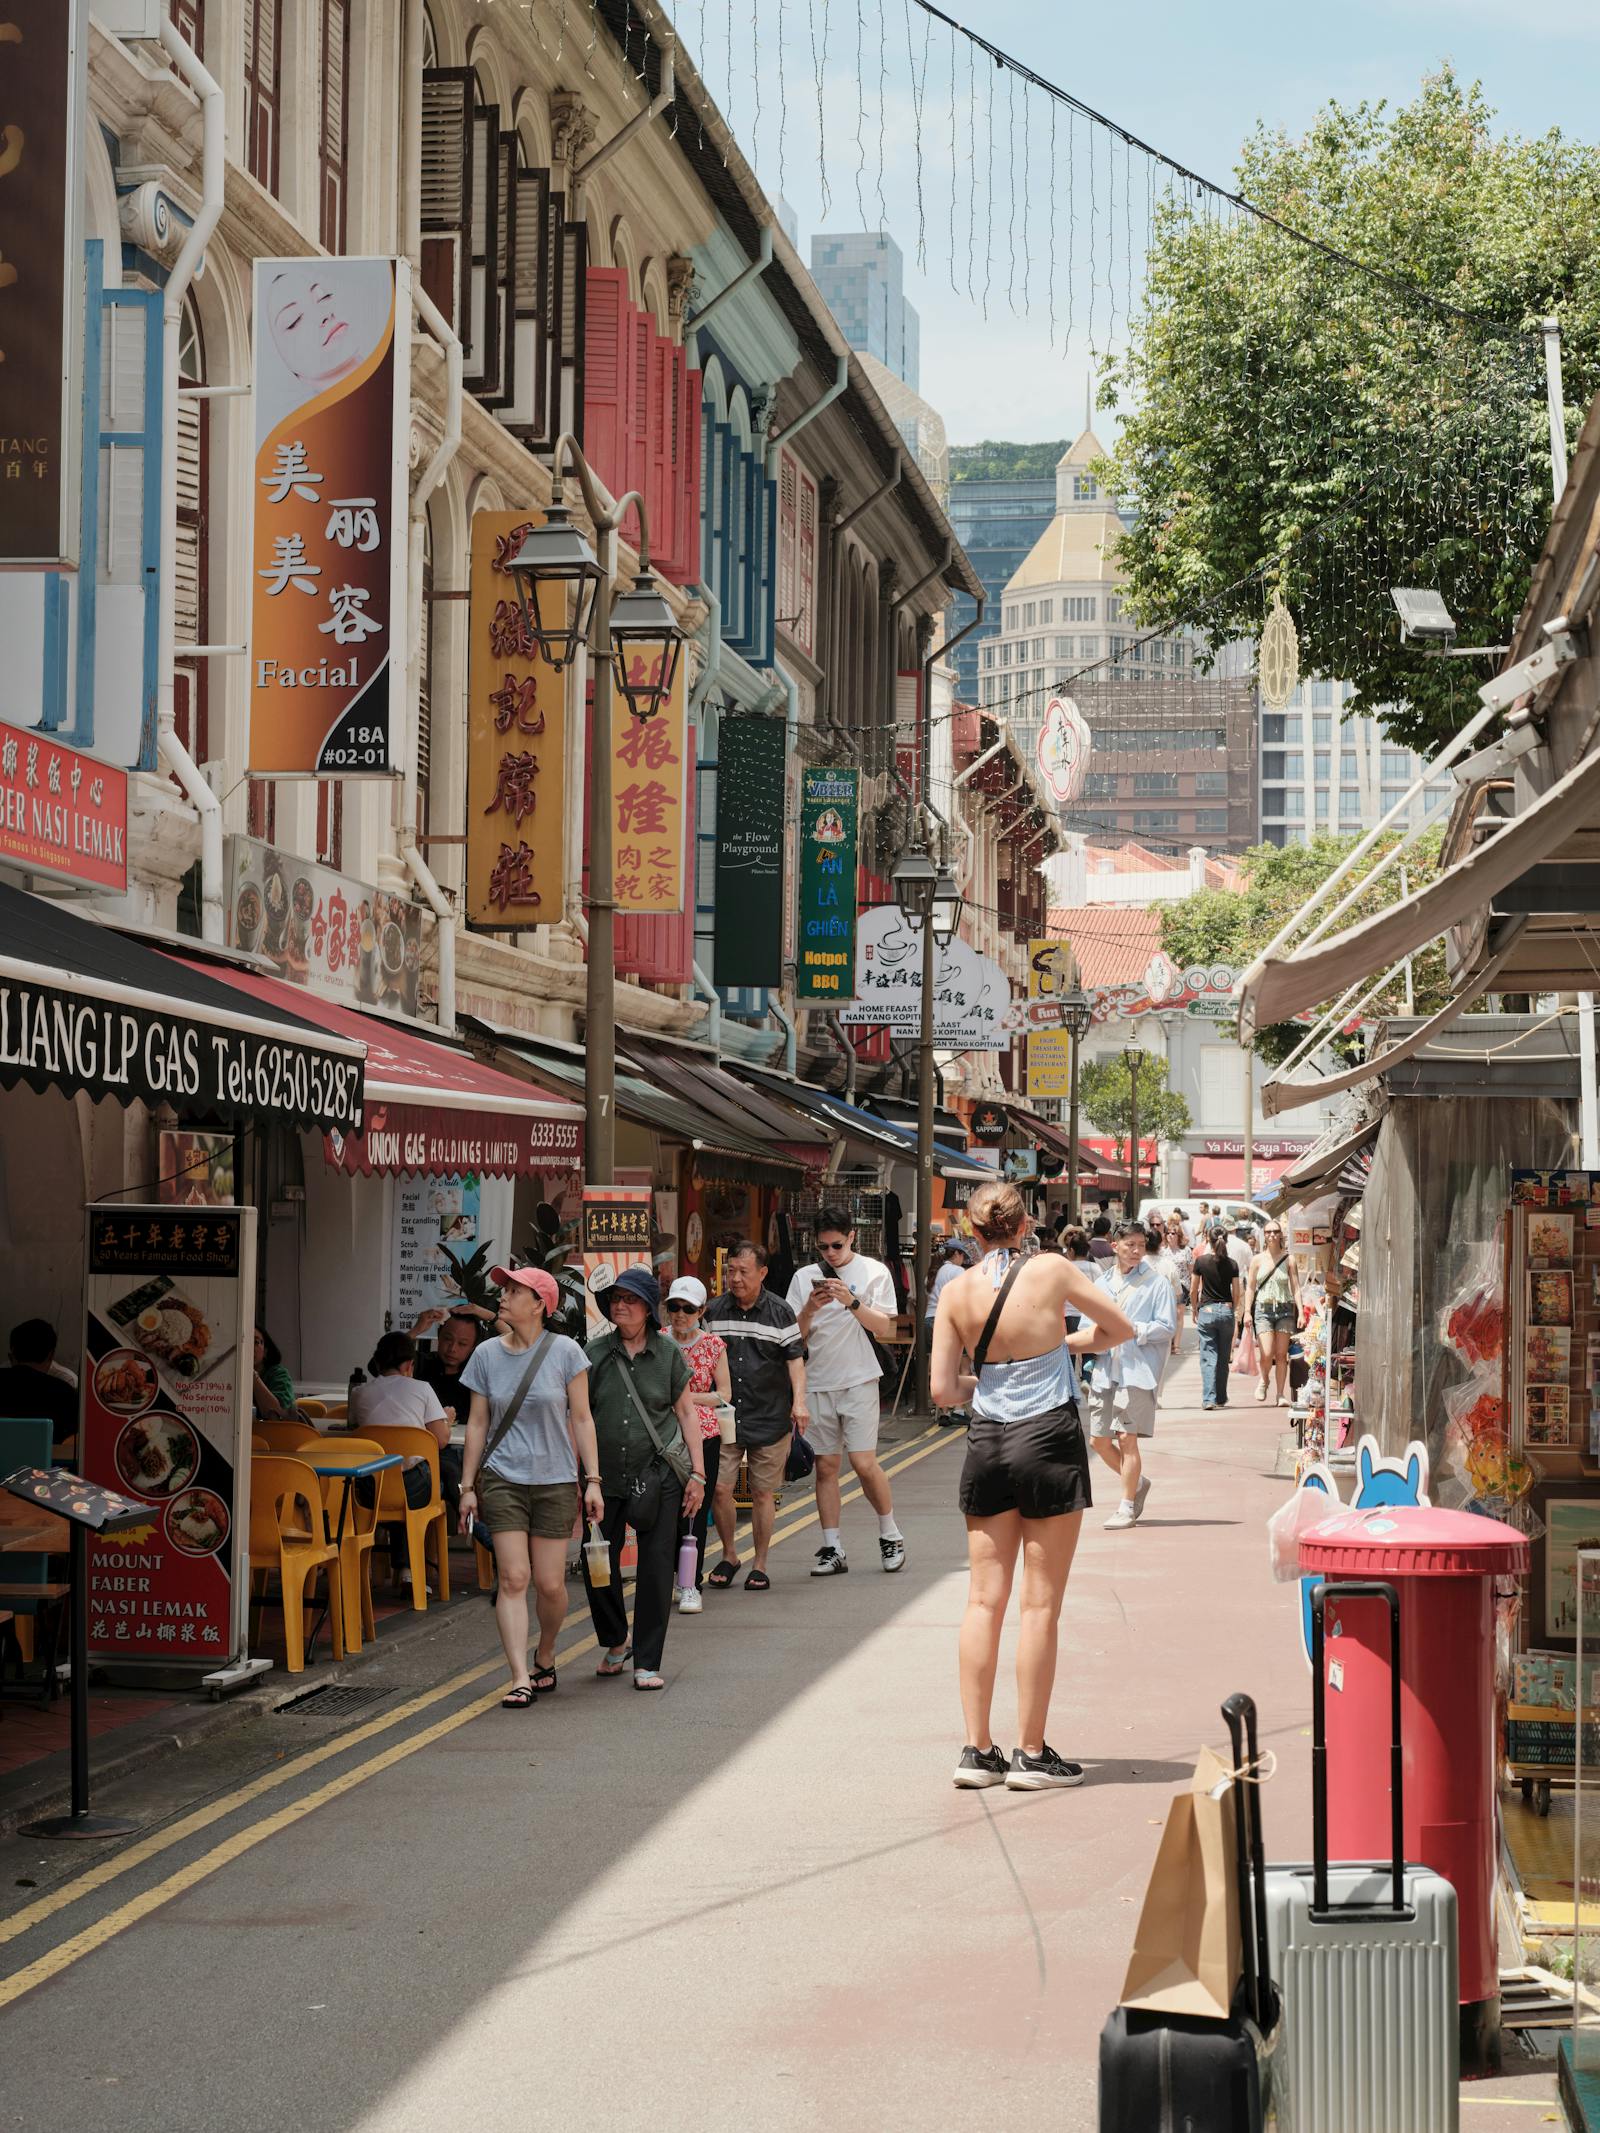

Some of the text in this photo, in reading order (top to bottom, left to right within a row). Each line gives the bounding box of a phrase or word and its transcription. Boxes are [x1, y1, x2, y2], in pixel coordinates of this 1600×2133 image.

[0, 438, 48, 454] TANG
[256, 657, 358, 688] Facial
[346, 727, 385, 744] 18A
[615, 653, 680, 835] 胡振隆
[324, 748, 385, 765] #02-01
[33, 798, 69, 848] NASI
[74, 812, 124, 864] LEMAK
[745, 832, 771, 842] Flow
[722, 842, 779, 856] Playground
[805, 950, 848, 966] Hotpot
[812, 973, 839, 991] BBQ
[846, 1013, 935, 1021] NAN YANG KOPITI
[0, 988, 97, 1079] LIANG
[103, 1011, 139, 1084] LP
[144, 1021, 201, 1095] GAS
[969, 1041, 1005, 1049] KOPITIAM
[598, 1094, 610, 1117] 7
[531, 1123, 579, 1149] 6333 5555
[975, 1125, 1003, 1133] SAPPORO
[367, 1132, 518, 1165] UNION GAS HOLDINGS LIMITED
[1207, 1142, 1220, 1152] Ya
[1282, 1142, 1314, 1152] Toast
[924, 1155, 931, 1168] 9
[402, 1193, 420, 1201] Facial
[401, 1217, 440, 1226] Ear candling
[99, 1223, 231, 1251] 五十年老字号
[400, 1240, 418, 1248] Scrub
[609, 1233, 626, 1242] Famous
[113, 1250, 139, 1261] Years
[141, 1250, 178, 1262] Famous
[181, 1251, 204, 1263] Food
[206, 1252, 231, 1264] Shop
[400, 1264, 429, 1272] Manicure
[433, 1264, 452, 1272] Pedic
[399, 1288, 422, 1297] Waxing
[399, 1312, 422, 1320] Cuppi
[175, 1381, 186, 1390] No
[183, 1393, 225, 1402] No Service
[176, 1405, 205, 1414] Charge
[91, 1552, 165, 1570] MOUNT
[91, 1576, 151, 1593] FABER
[90, 1599, 208, 1618] NASI LEMAK
[90, 1620, 221, 1642] 花芭山椰浆饭
